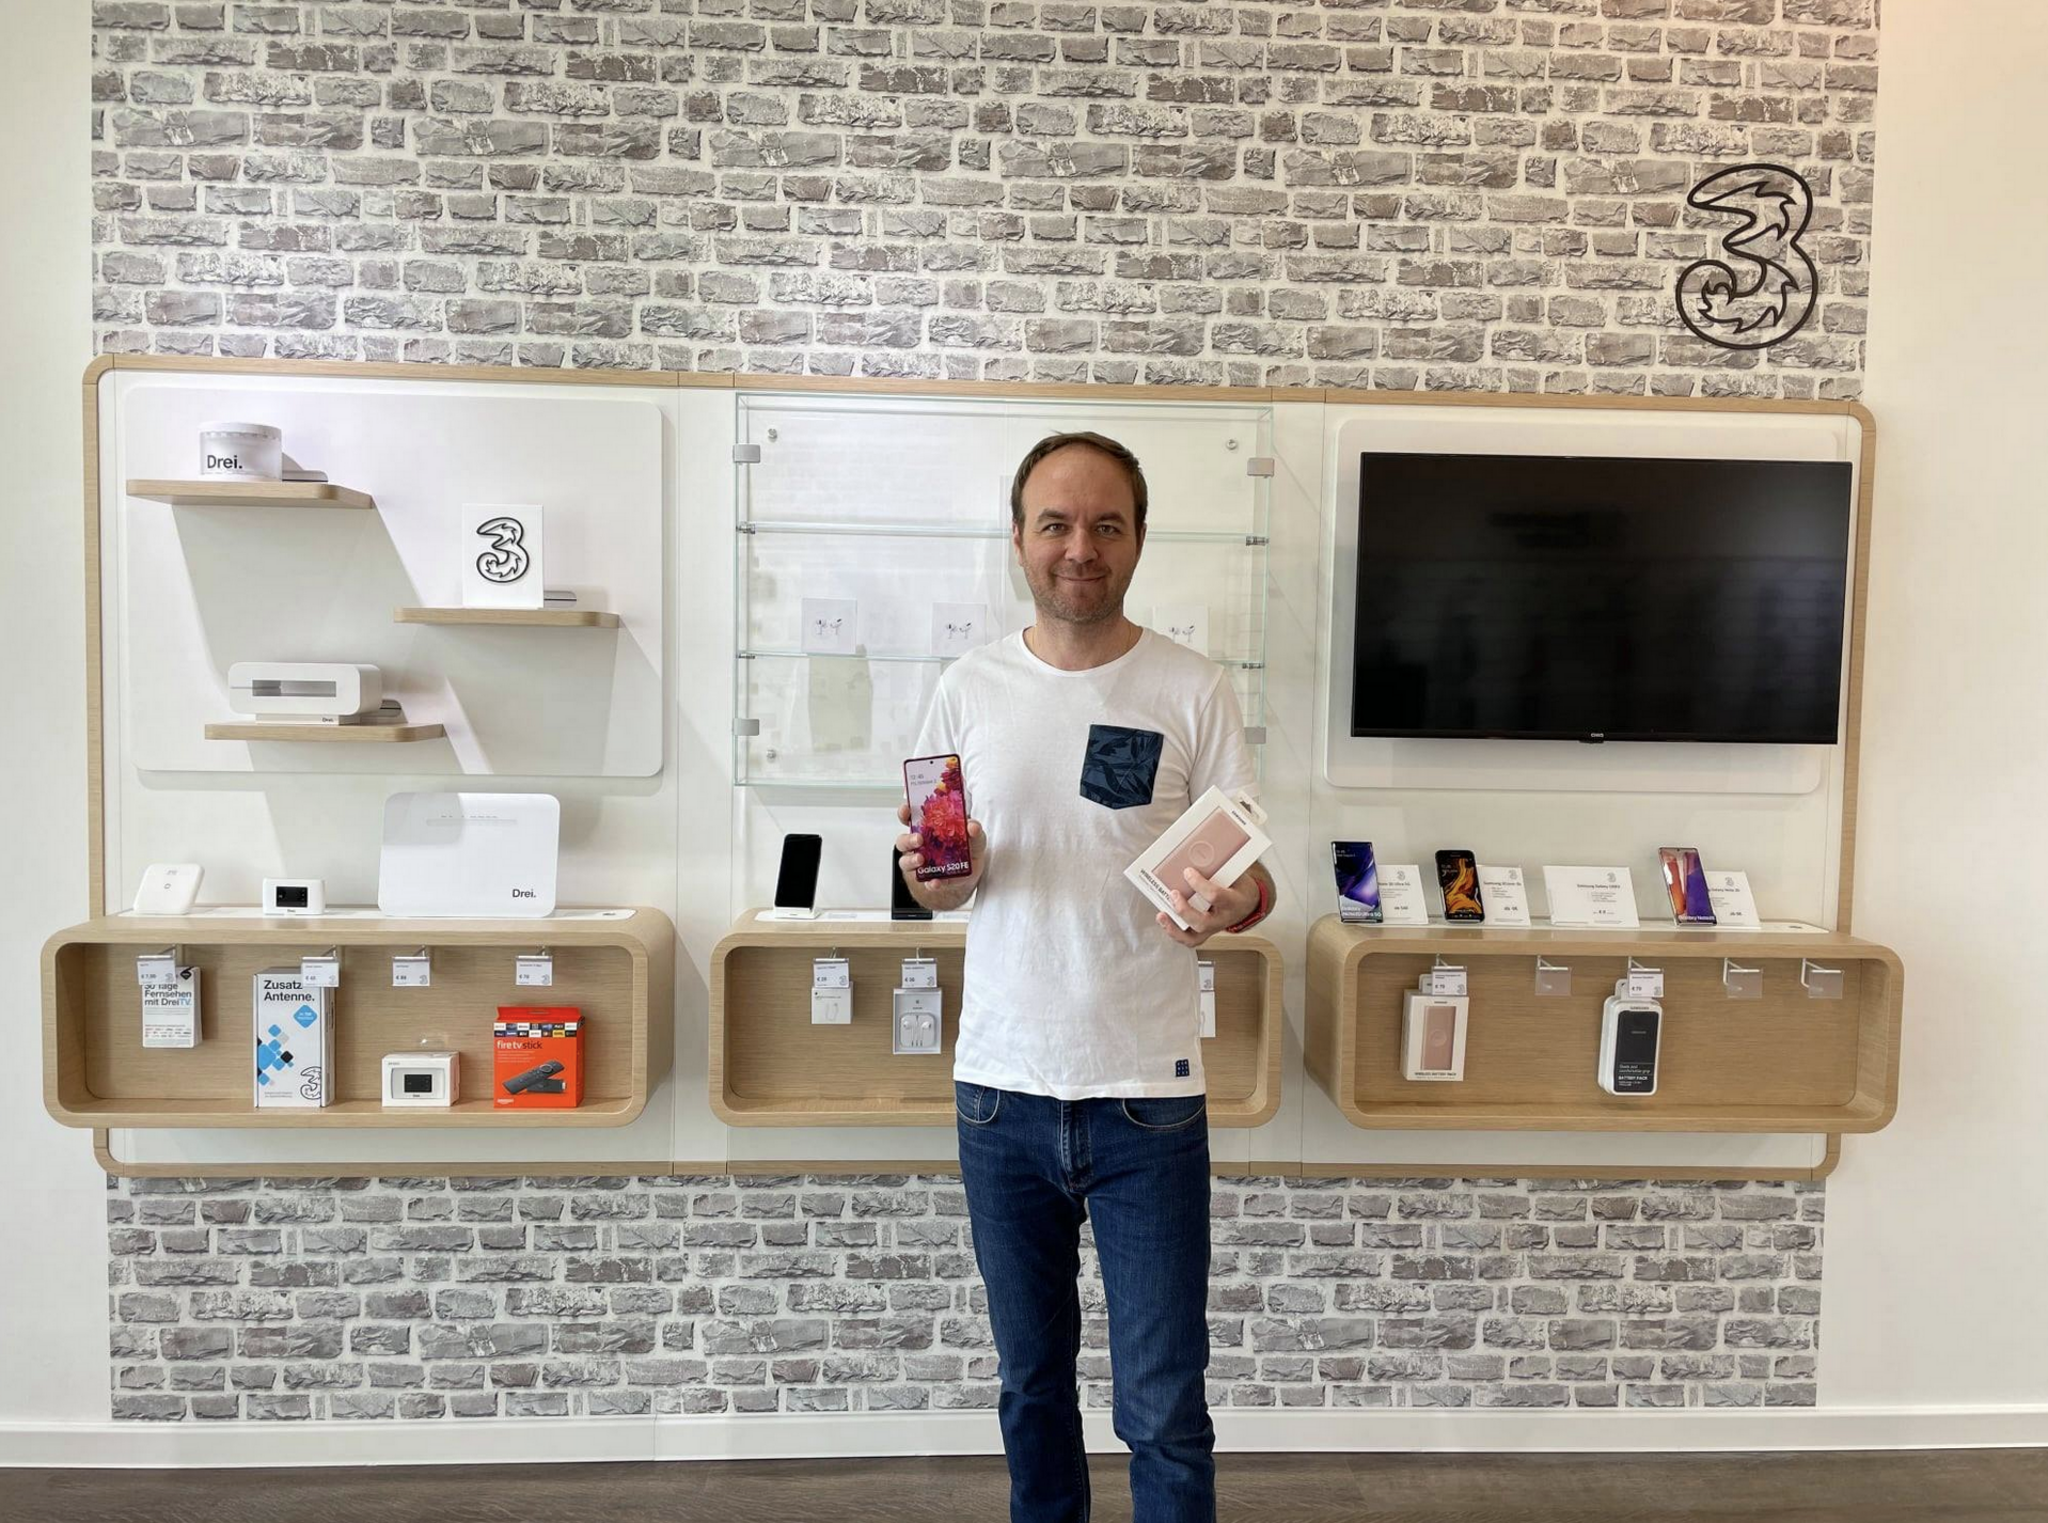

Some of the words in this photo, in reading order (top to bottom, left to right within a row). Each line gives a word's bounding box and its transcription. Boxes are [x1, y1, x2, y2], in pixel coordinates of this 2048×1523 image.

[1675, 163, 1819, 350] 3
[207, 454, 243, 469] Drei.
[476, 516, 529, 583] 3
[917, 866, 946, 874] Galaxy
[946, 863, 960, 871] S20
[961, 861, 969, 869] FE
[512, 888, 537, 898] Drei.
[264, 980, 303, 990] Zusatz
[144, 990, 192, 998] Fernsehen
[264, 992, 315, 1001] Antenne.
